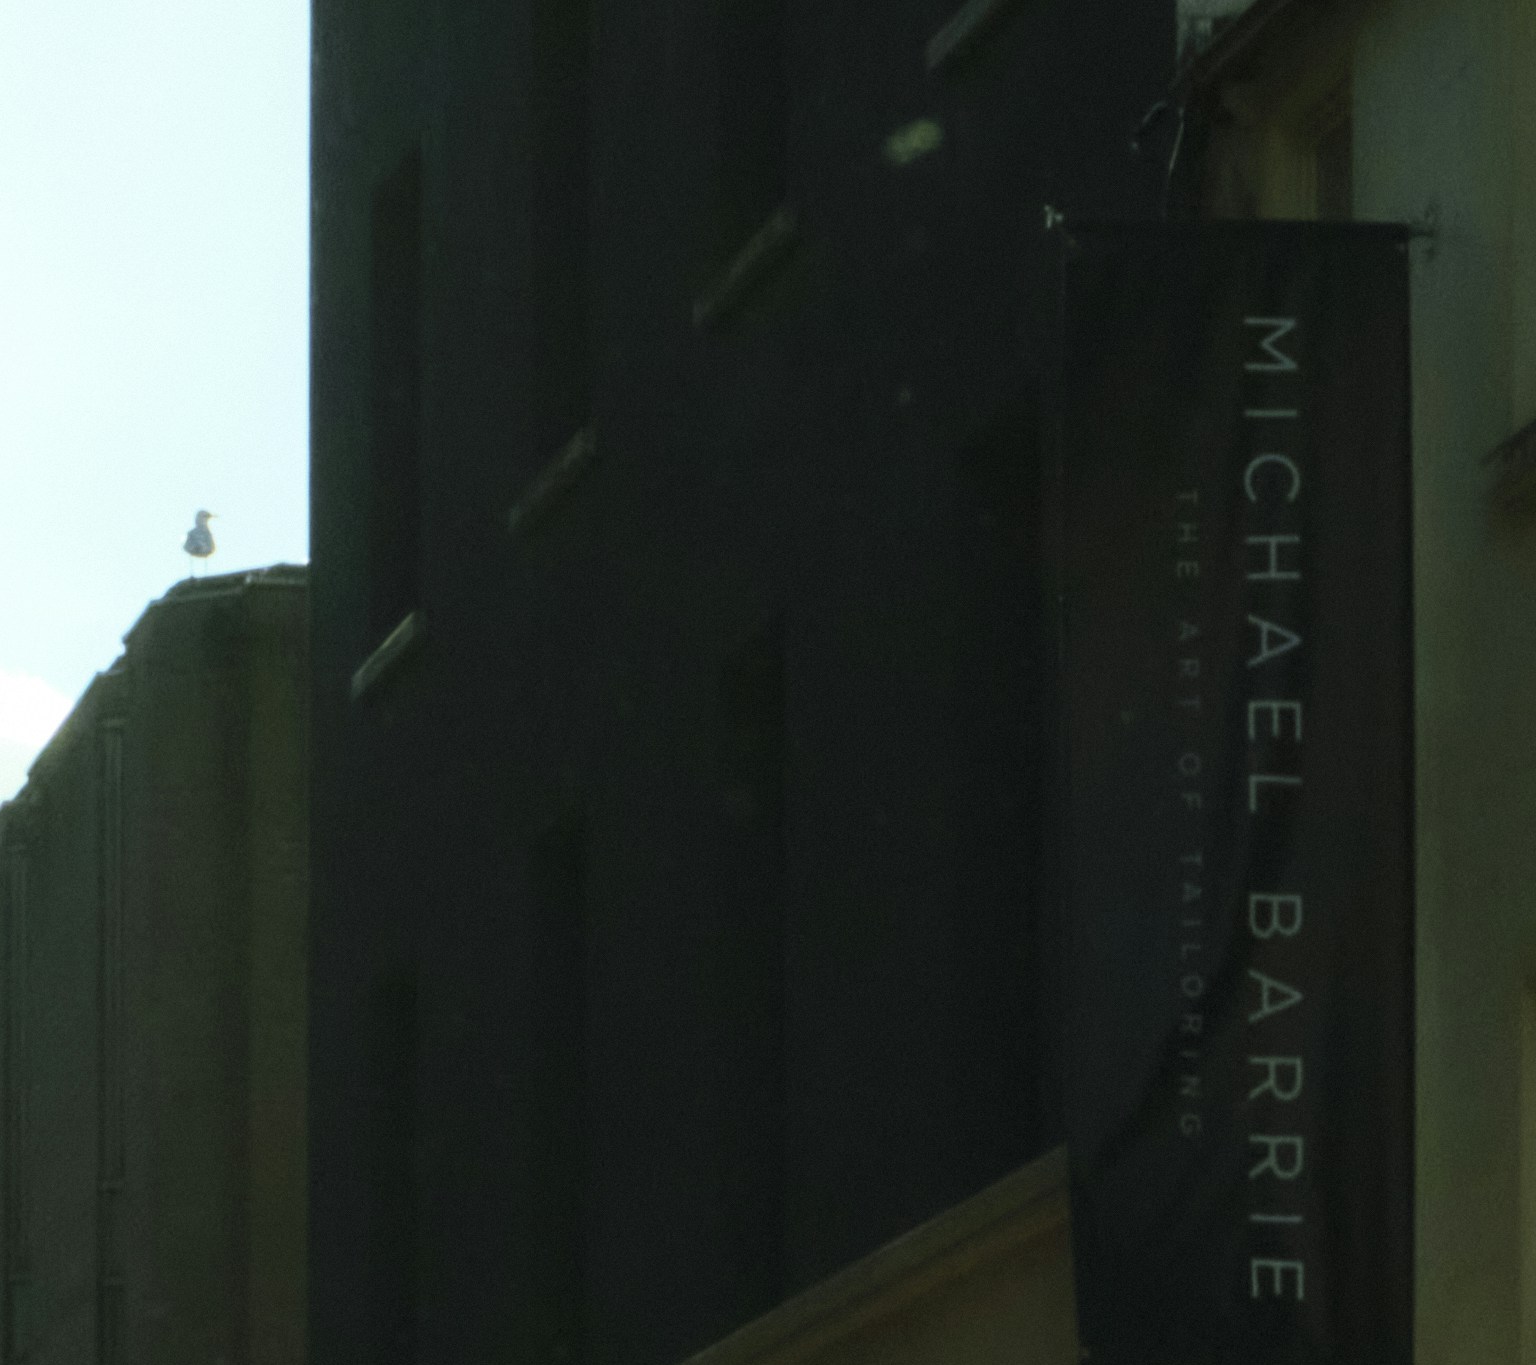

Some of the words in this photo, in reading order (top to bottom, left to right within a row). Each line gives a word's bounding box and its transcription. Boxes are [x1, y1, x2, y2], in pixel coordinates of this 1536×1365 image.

[1175, 488, 1201, 579] THE
[1243, 315, 1303, 815] MICHAEL
[1176, 618, 1203, 714] ART
[1177, 751, 1204, 811] OF
[1179, 851, 1205, 1139] TAILORING
[1247, 892, 1306, 1301] BARRIE
